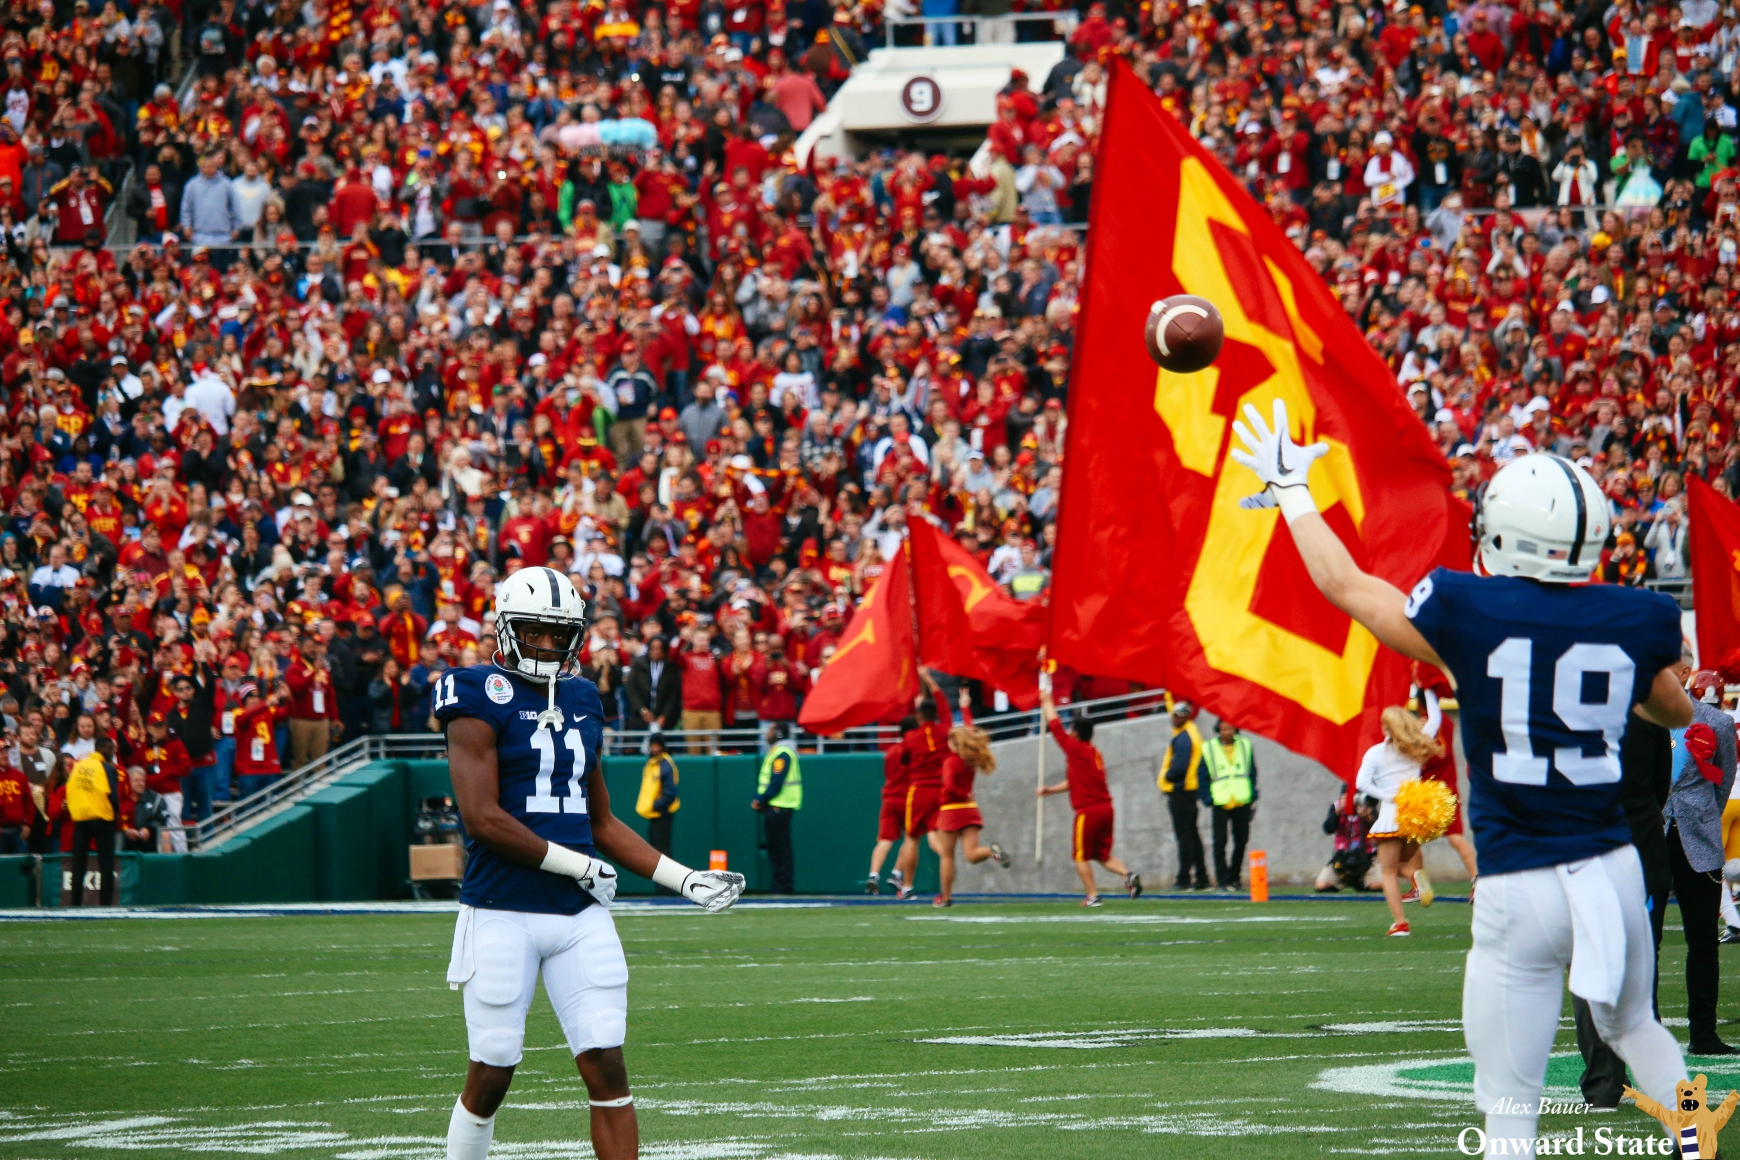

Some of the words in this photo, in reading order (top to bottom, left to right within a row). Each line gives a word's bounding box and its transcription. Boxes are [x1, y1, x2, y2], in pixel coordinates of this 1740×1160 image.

[909, 81, 934, 113] 9
[434, 674, 459, 711] 11
[1487, 637, 1636, 786] 19
[526, 728, 587, 815] 11
